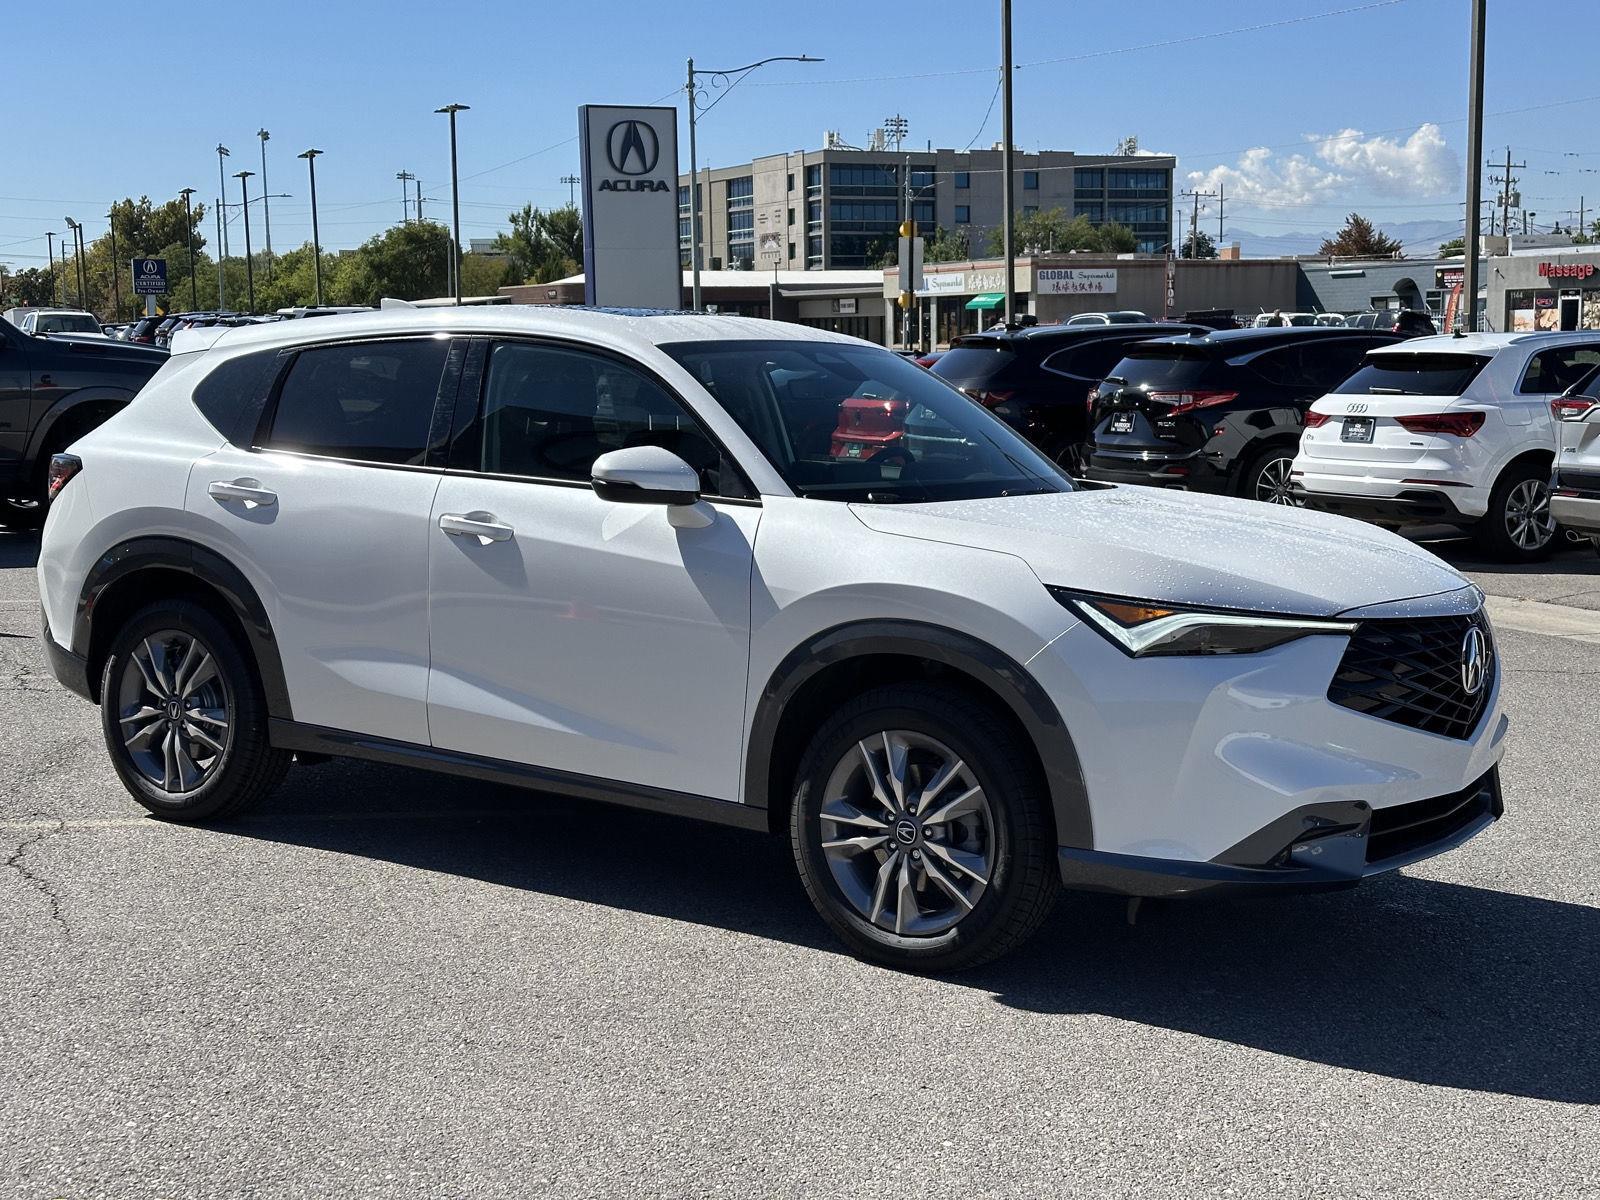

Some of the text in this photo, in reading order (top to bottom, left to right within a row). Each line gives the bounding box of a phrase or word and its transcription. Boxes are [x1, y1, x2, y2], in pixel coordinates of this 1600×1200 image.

[598, 179, 670, 192] ACURA
[1039, 270, 1074, 280] GLOBAL
[1538, 262, 1594, 280] Massage
